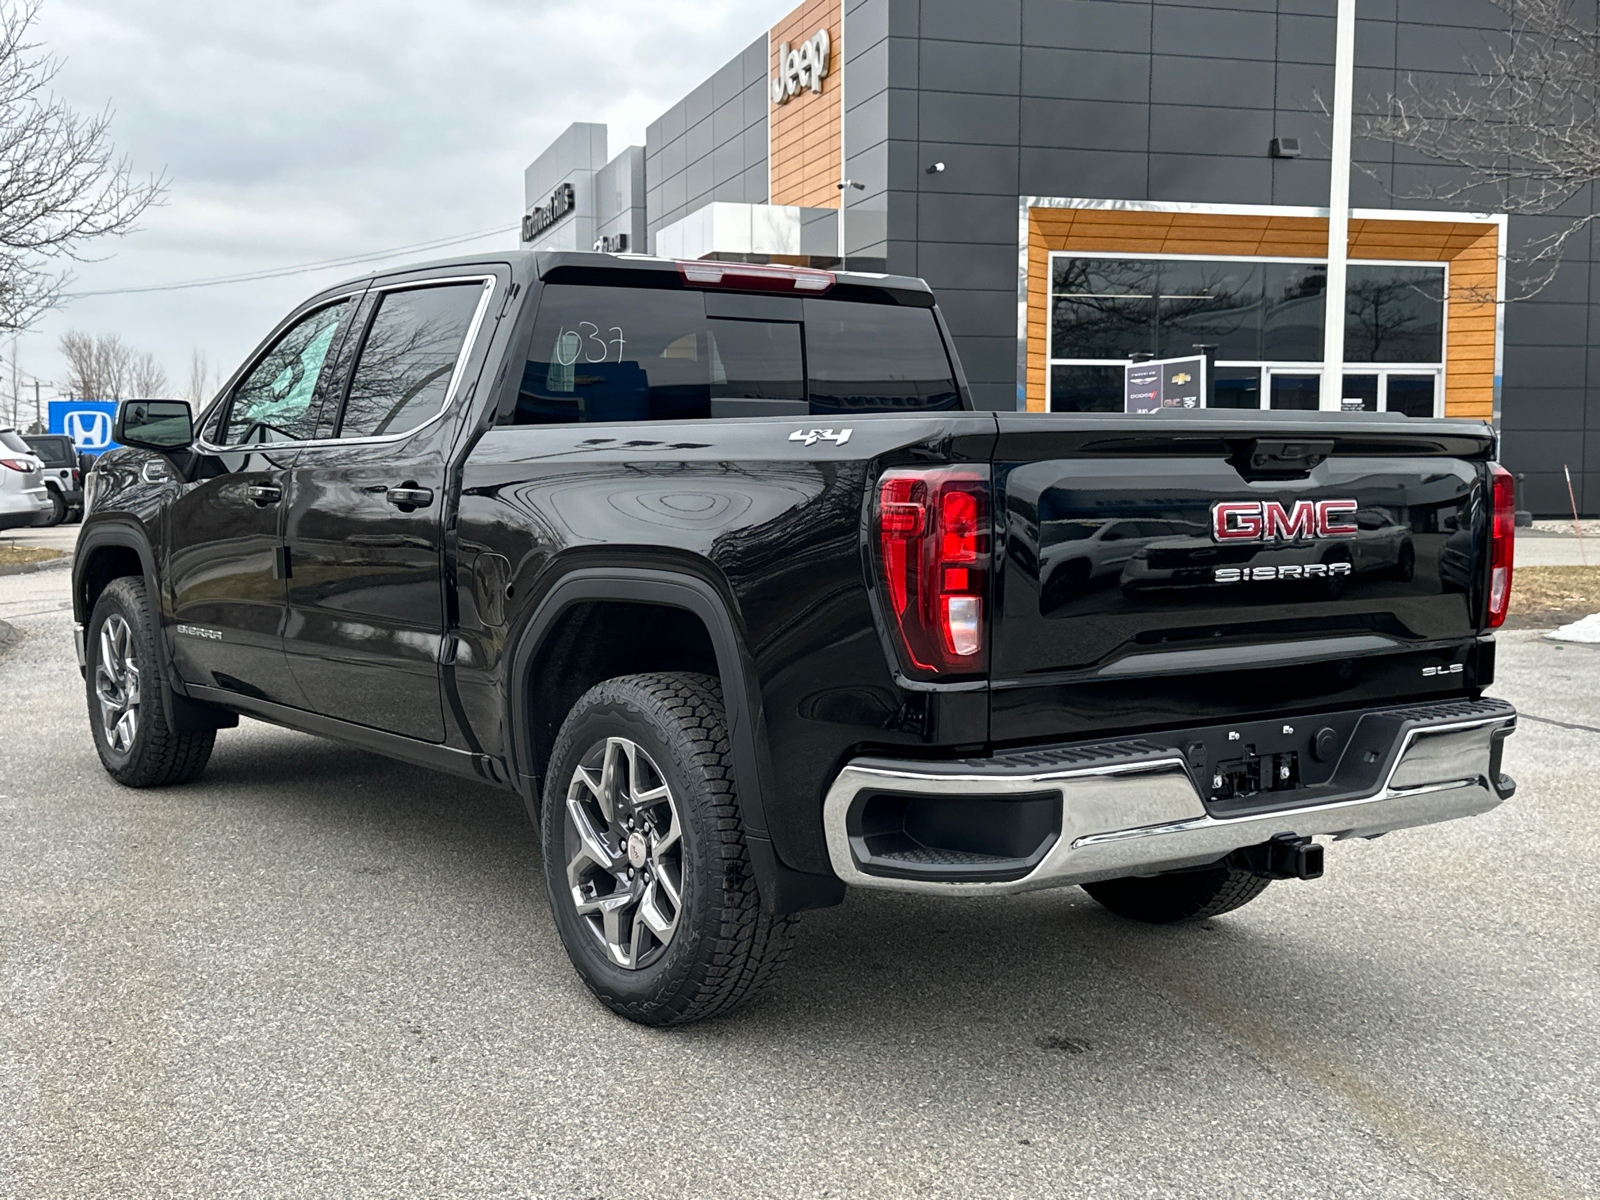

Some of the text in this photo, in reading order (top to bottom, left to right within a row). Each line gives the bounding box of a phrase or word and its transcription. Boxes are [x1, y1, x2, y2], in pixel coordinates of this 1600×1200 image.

[772, 28, 831, 105] Jeep
[557, 322, 627, 366] 037
[1212, 500, 1358, 543] GMC
[1214, 562, 1352, 583] SIERRA
[176, 624, 223, 641] SIERRA
